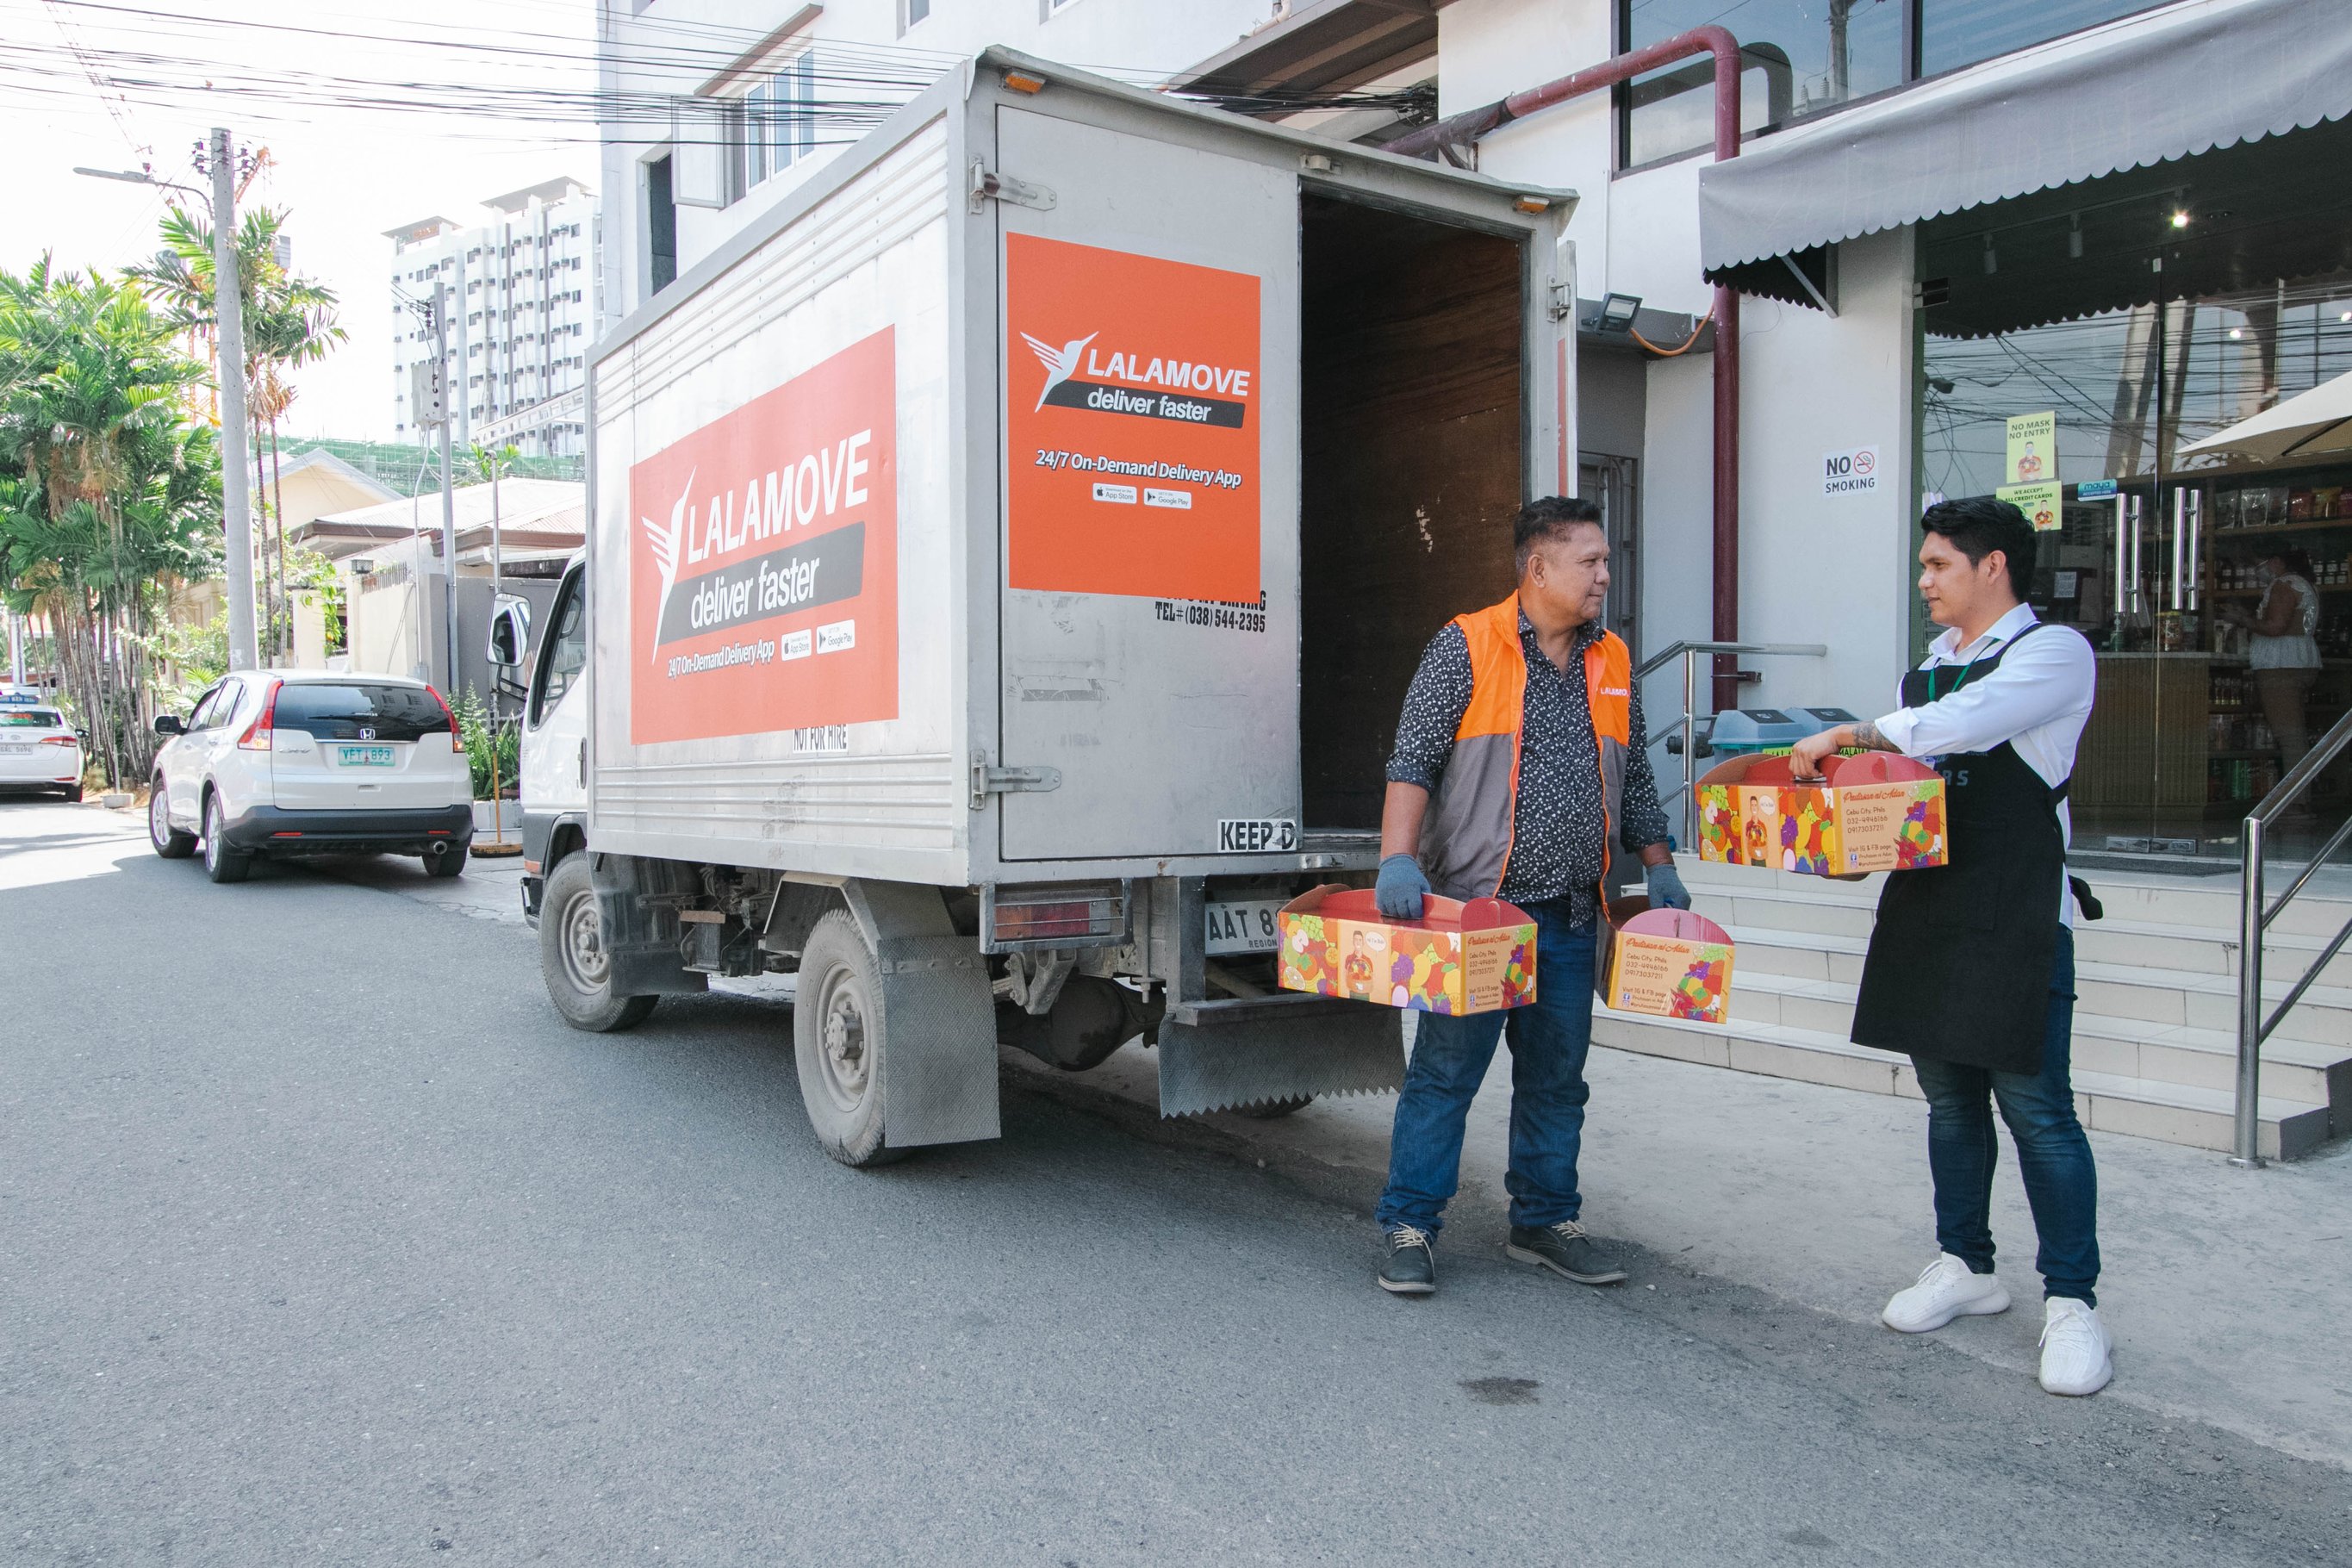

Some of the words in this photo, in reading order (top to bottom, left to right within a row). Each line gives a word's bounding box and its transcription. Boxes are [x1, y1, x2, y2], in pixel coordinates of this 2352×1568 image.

[1087, 348, 1251, 396] LALAMOVE
[1087, 387, 1155, 415] deliver
[1159, 395, 1212, 422] faster
[2024, 427, 2050, 438] ENTRY
[2026, 420, 2050, 429] MASK
[1036, 449, 1069, 471] 24/7
[1071, 453, 1158, 476] On-Demand
[1159, 462, 1214, 486] Delivery
[1214, 469, 1241, 489] App
[1826, 456, 1851, 476] NO
[1826, 477, 1876, 494] SMOKING
[2084, 482, 2110, 490] maya
[688, 428, 871, 565] LALAMOVE
[1105, 491, 1118, 500] App
[1119, 492, 1134, 501] Store
[1158, 496, 1177, 505] Google
[1178, 497, 1189, 507] Play
[691, 576, 753, 629] deliver
[758, 557, 819, 611] faster
[828, 635, 843, 647] Google
[668, 656, 681, 679] 24/7
[681, 645, 725, 675] On-Demand
[725, 642, 757, 666] Delivery
[756, 638, 775, 663] App
[793, 727, 808, 751] NOT
[810, 725, 825, 750] FOR
[828, 724, 847, 750] HIRE
[343, 749, 362, 760] VFT
[371, 749, 391, 760] 893
[1220, 821, 1273, 851] KEEP
[1208, 909, 1248, 941] AAT
[1248, 938, 1278, 949] REGION
